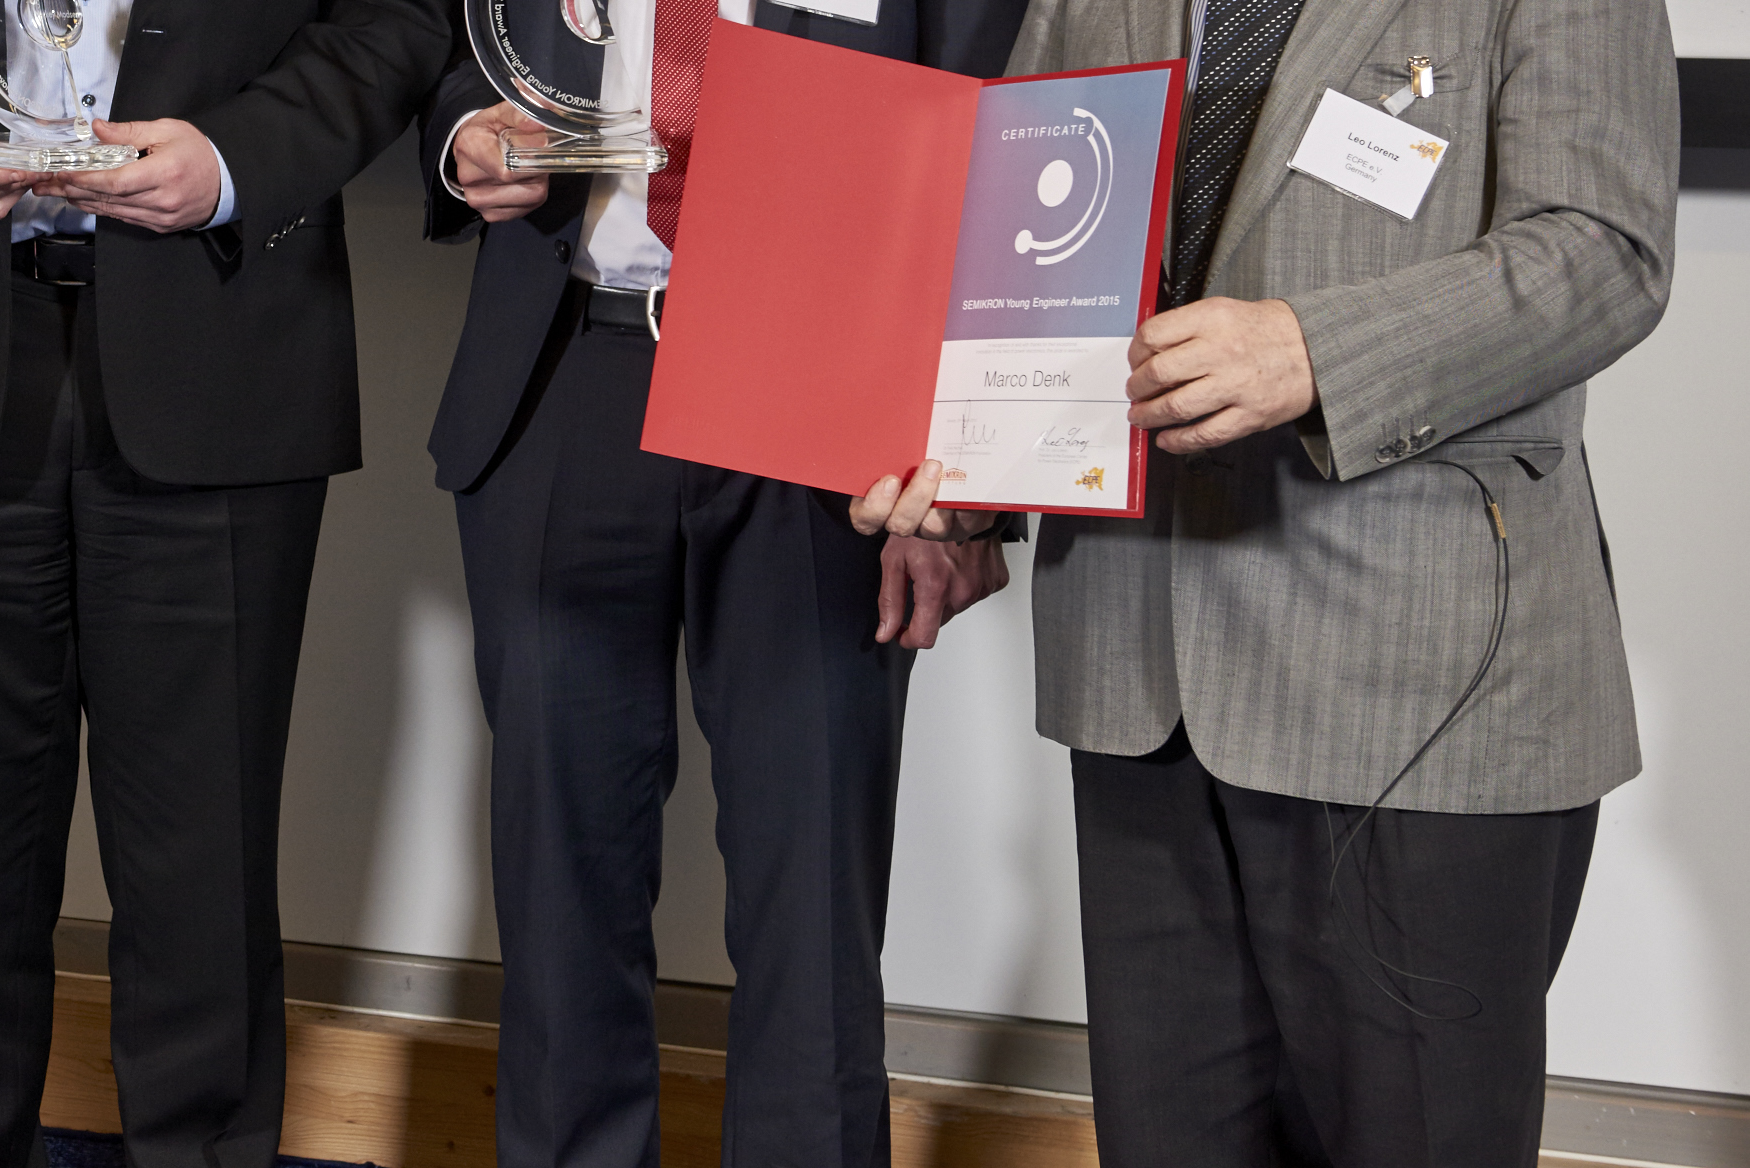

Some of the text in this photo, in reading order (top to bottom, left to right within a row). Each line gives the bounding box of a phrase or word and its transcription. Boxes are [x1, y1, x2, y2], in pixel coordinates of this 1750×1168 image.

[1001, 124, 1086, 141] CERTIFICATE
[1347, 132, 1400, 162] Leo Lorenz
[1346, 153, 1369, 168] ECPE
[1345, 163, 1378, 183] Germany
[962, 295, 1120, 310] SEMIKRON Young Engineer Award 2015
[984, 370, 1071, 388] Marco Denk
